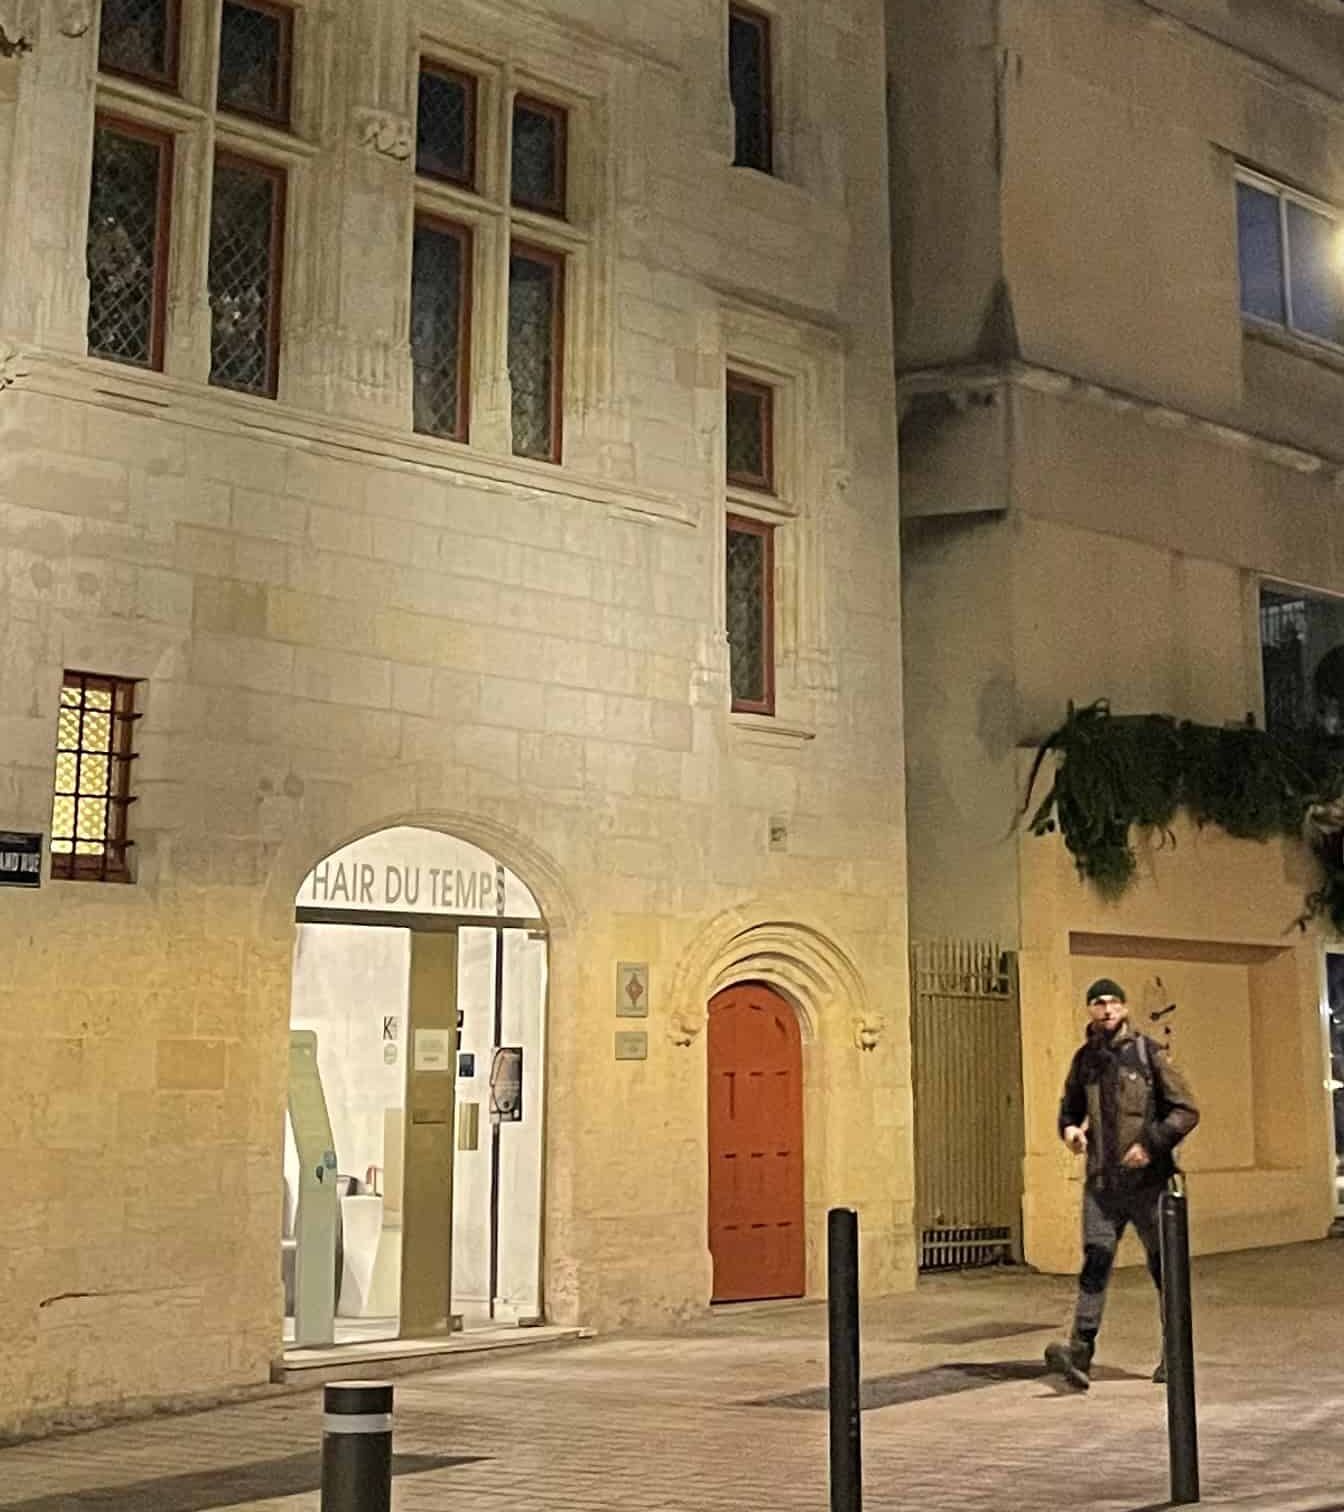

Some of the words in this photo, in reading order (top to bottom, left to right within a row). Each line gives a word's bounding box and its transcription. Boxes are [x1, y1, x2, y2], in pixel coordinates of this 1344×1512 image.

[311, 861, 375, 904] HAIR
[385, 865, 420, 906] DU
[429, 865, 505, 916] TEMPS
